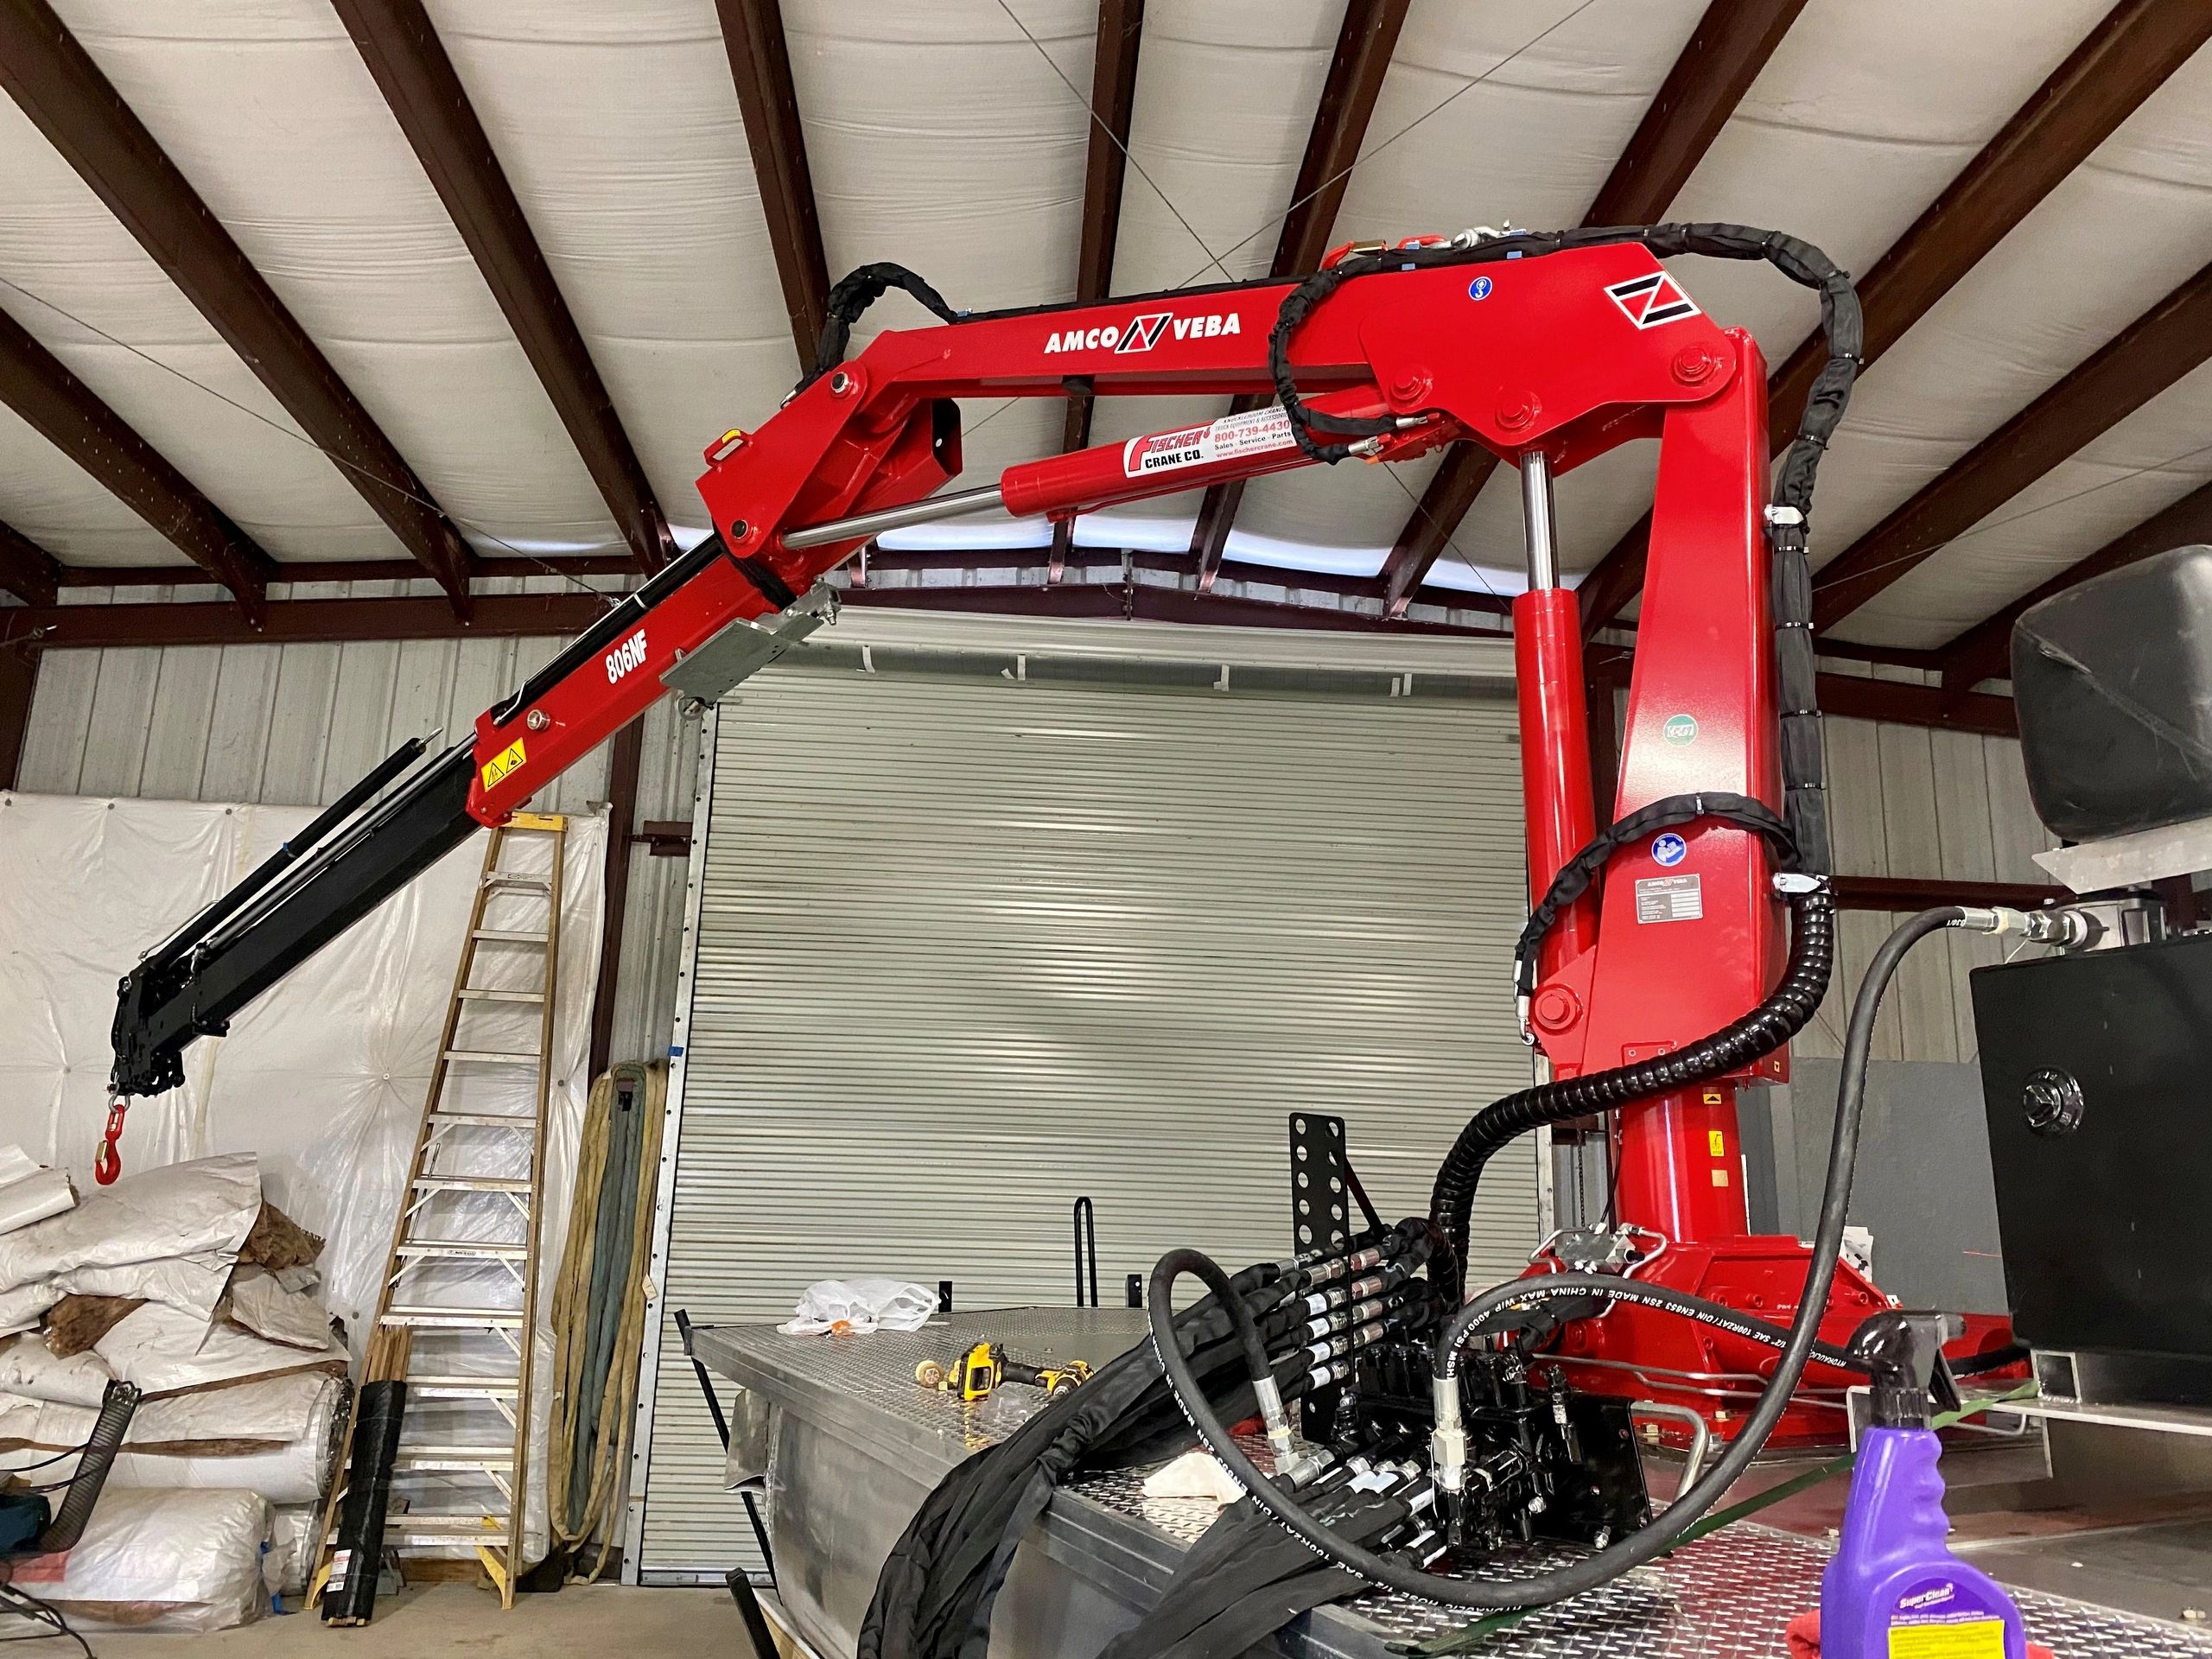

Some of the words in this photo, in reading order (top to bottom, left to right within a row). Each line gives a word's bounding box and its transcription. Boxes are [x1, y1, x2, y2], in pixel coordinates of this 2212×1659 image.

[1043, 326, 1119, 354] AMCO
[1173, 313, 1241, 340] VEBA
[1214, 420, 1290, 442] 800-739-4430
[1239, 435, 1266, 446] Service
[1216, 439, 1294, 458] www.fischercrane.com
[1145, 452, 1182, 469] CRANE
[1184, 449, 1204, 461] CO.
[606, 629, 647, 684] 806NF
[1519, 1289, 1546, 1302] MAX
[1550, 1287, 1587, 1297] CHINA
[1591, 1288, 1604, 1297] IN
[1607, 1289, 1640, 1303] MADE
[1642, 1295, 1663, 1308] 2SN
[1467, 1311, 1491, 1332] 4000
[1454, 1329, 1470, 1348] PSI
[1752, 1330, 1771, 1343] SAE
[1808, 1348, 1847, 1368] HYDRAULIC
[1337, 1560, 1364, 1580] SAE
[1899, 1587, 1951, 1609] SuperClean
